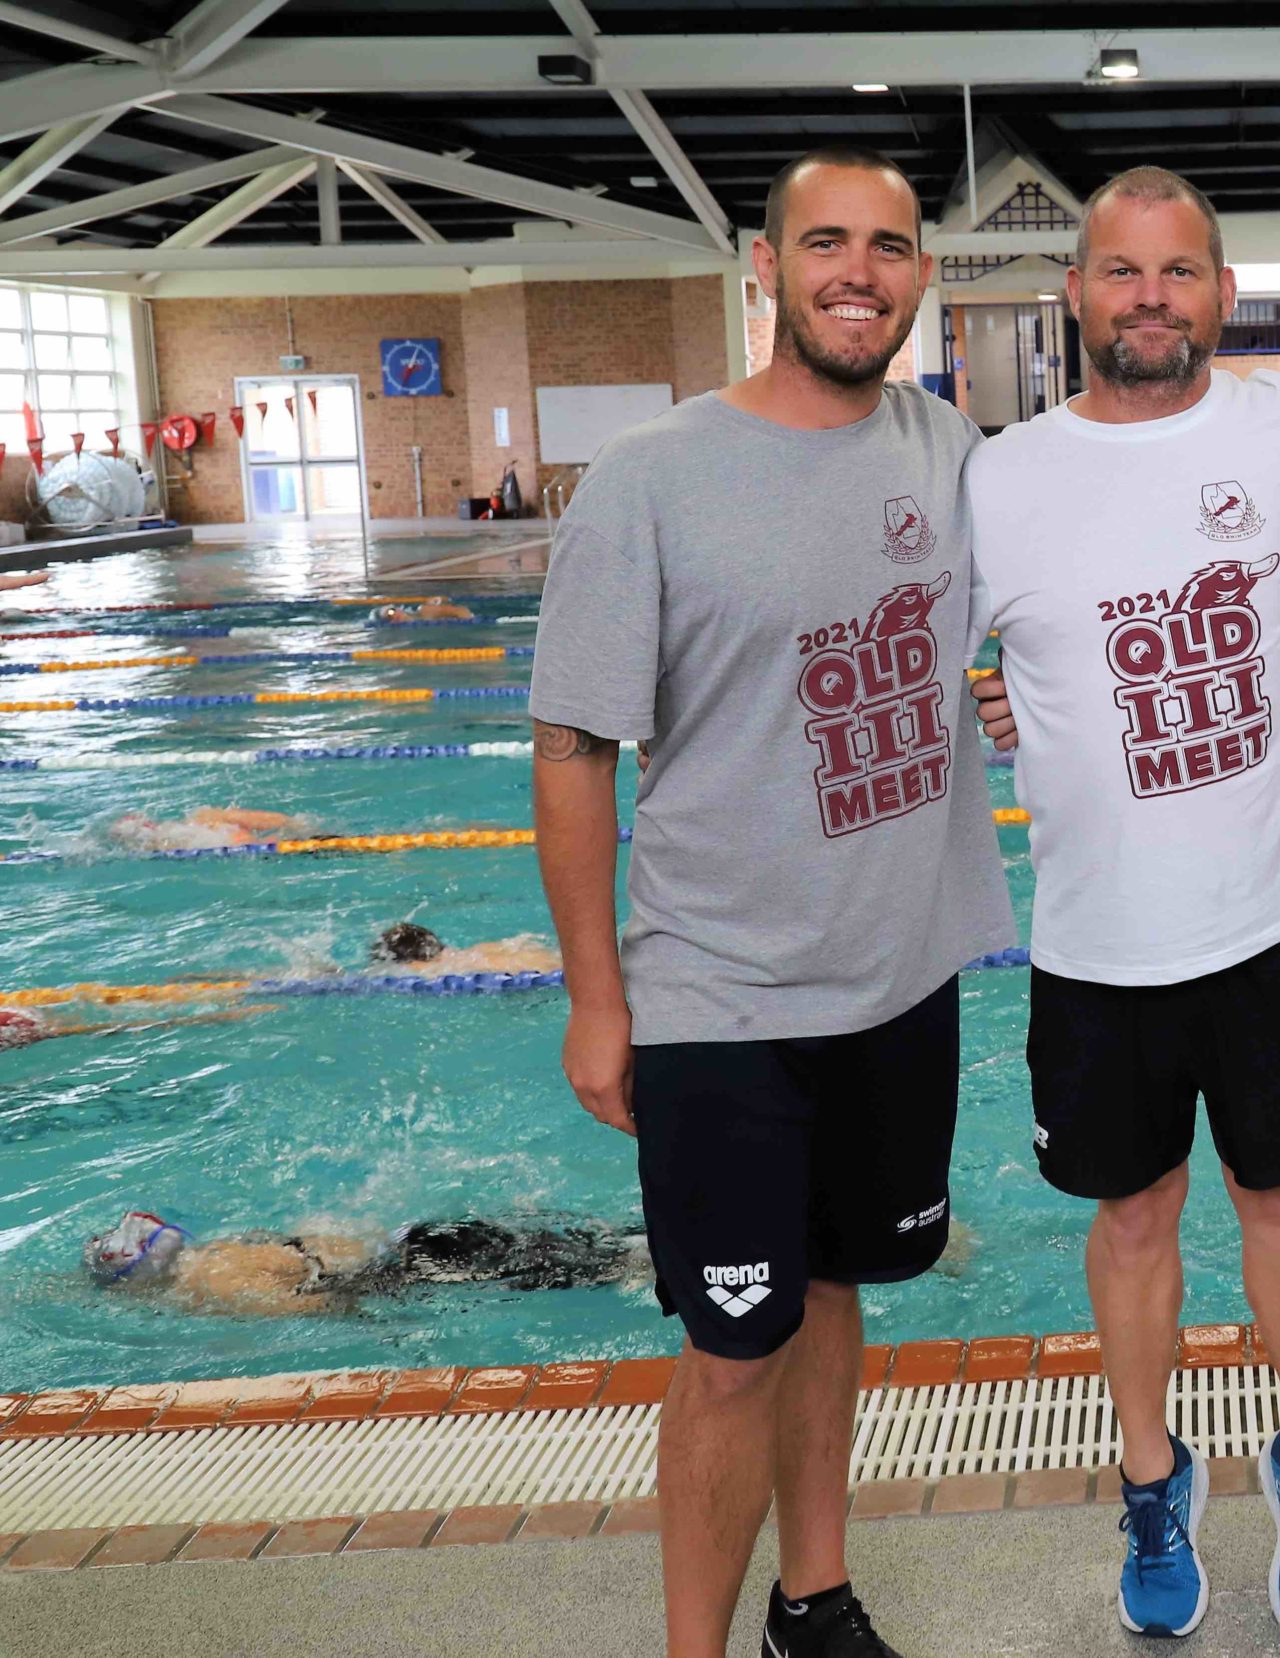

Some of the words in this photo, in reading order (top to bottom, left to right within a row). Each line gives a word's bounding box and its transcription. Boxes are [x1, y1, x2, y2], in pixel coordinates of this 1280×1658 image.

[797, 618, 859, 654] 2021
[1098, 589, 1171, 622] 2021
[800, 631, 936, 716] QLD
[1109, 606, 1259, 684] QLD
[808, 686, 948, 786] III
[1117, 660, 1269, 747] III
[820, 751, 948, 836] MEET
[1129, 718, 1270, 796] MEET
[703, 1261, 769, 1286] arena
